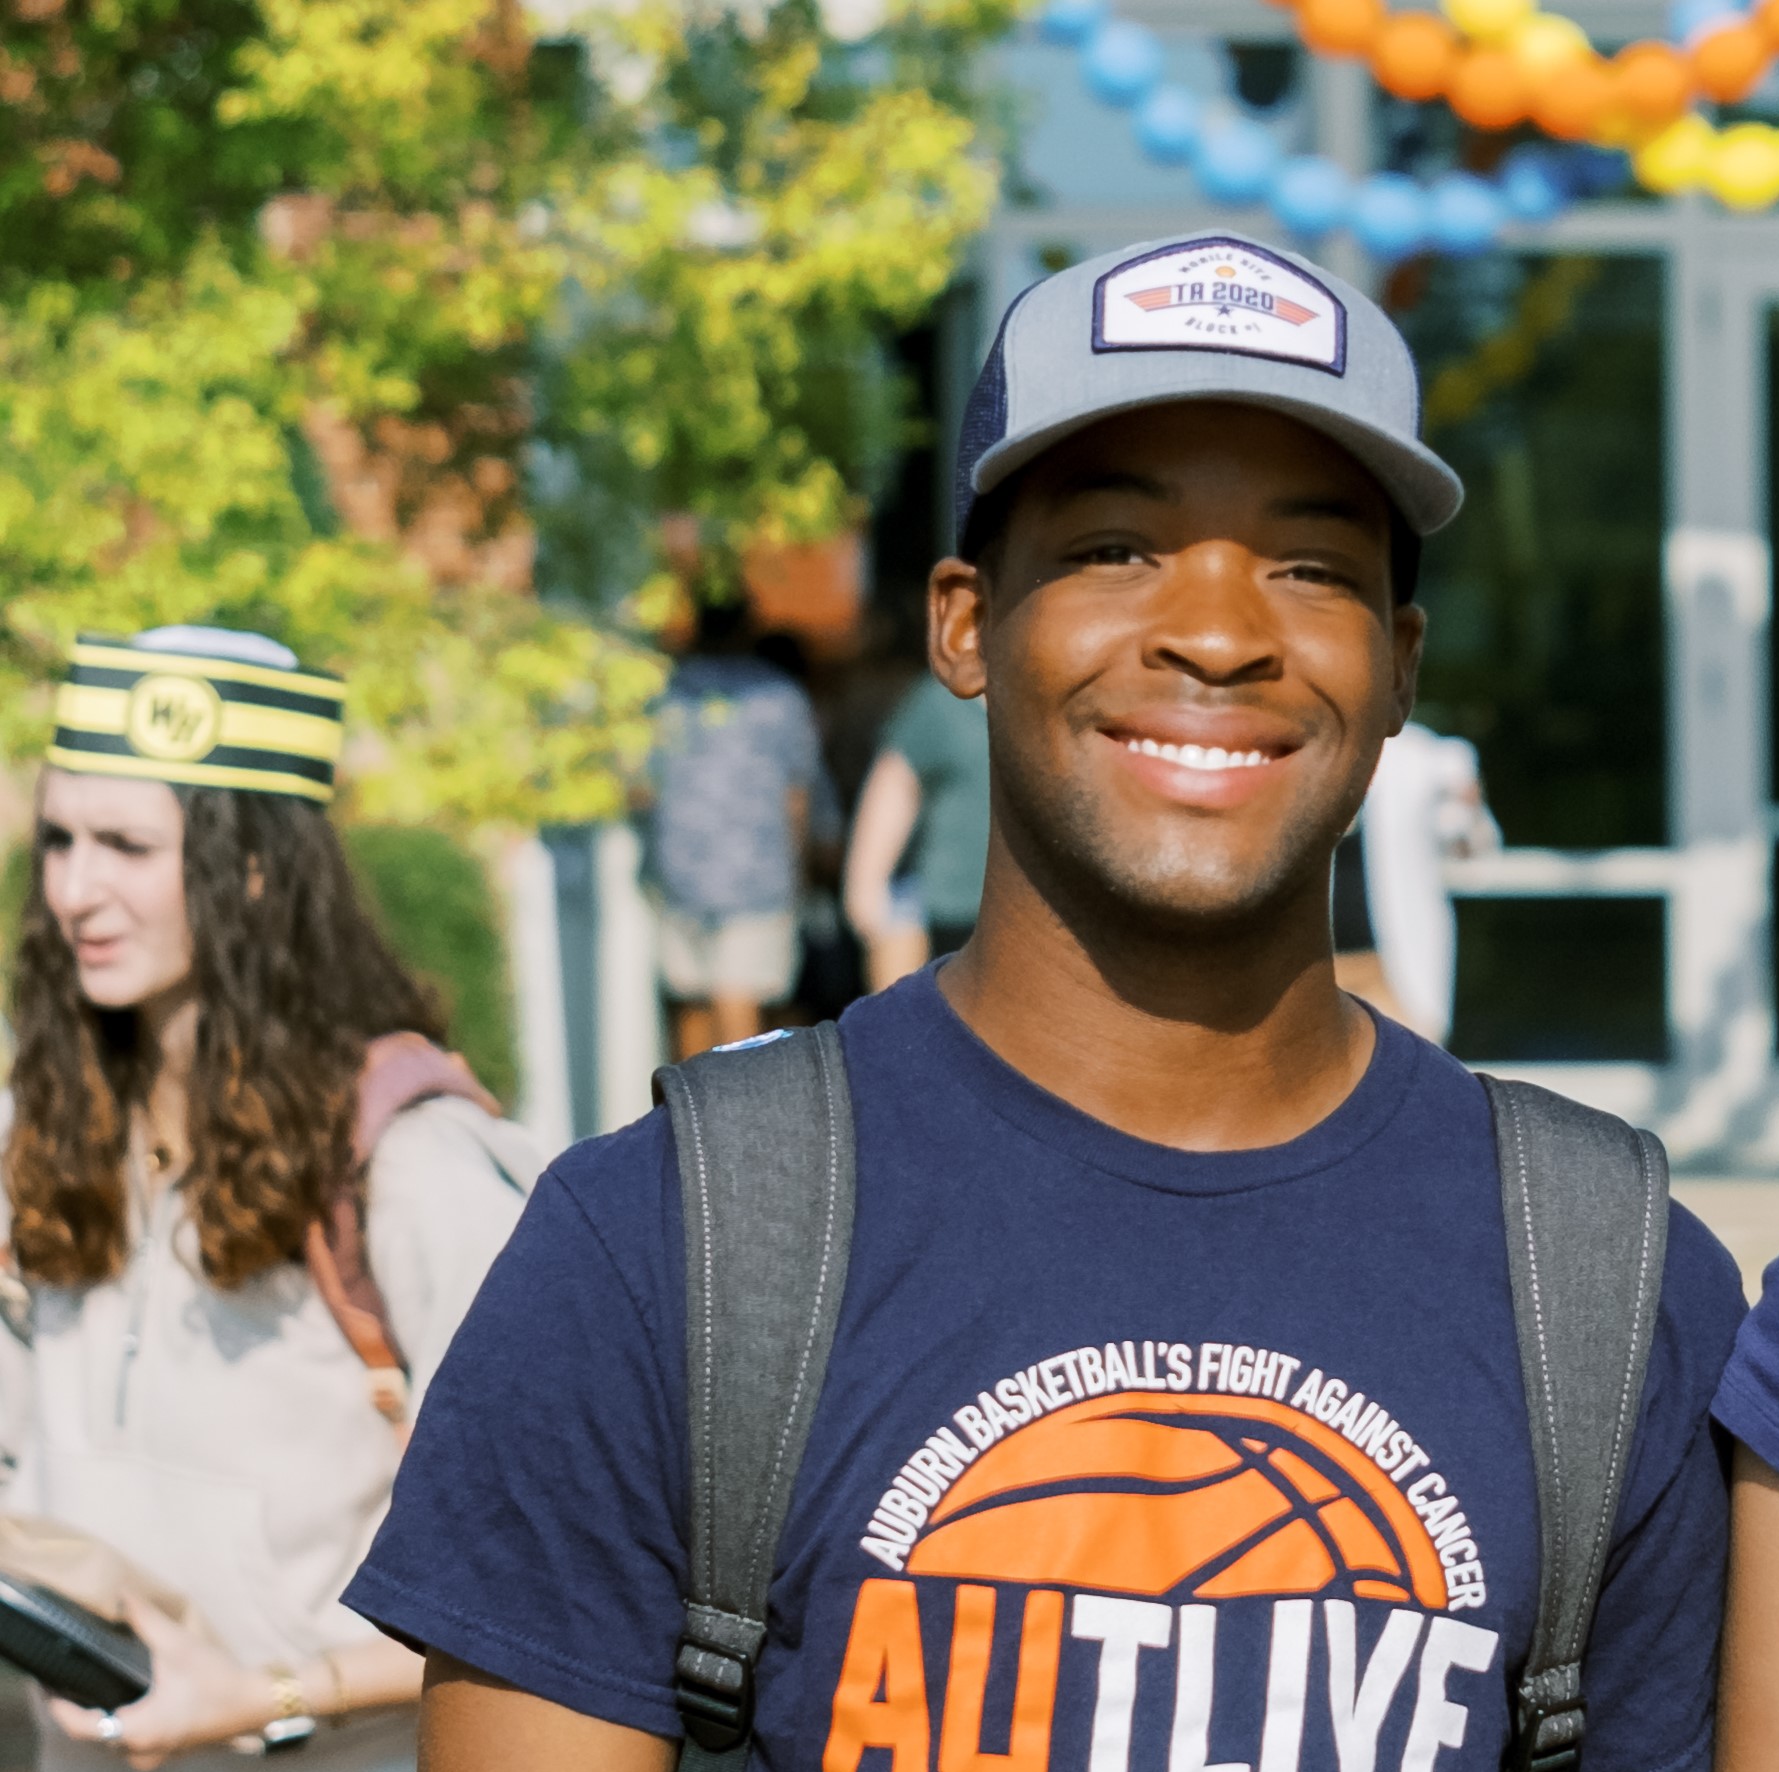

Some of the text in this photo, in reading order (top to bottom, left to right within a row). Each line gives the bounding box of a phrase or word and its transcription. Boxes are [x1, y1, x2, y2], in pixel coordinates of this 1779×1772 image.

[1173, 281, 1275, 312] TA 2020
[860, 1340, 1487, 1613] AUBURN BASKETBALL'S FIGHT AGAINST CANCER
